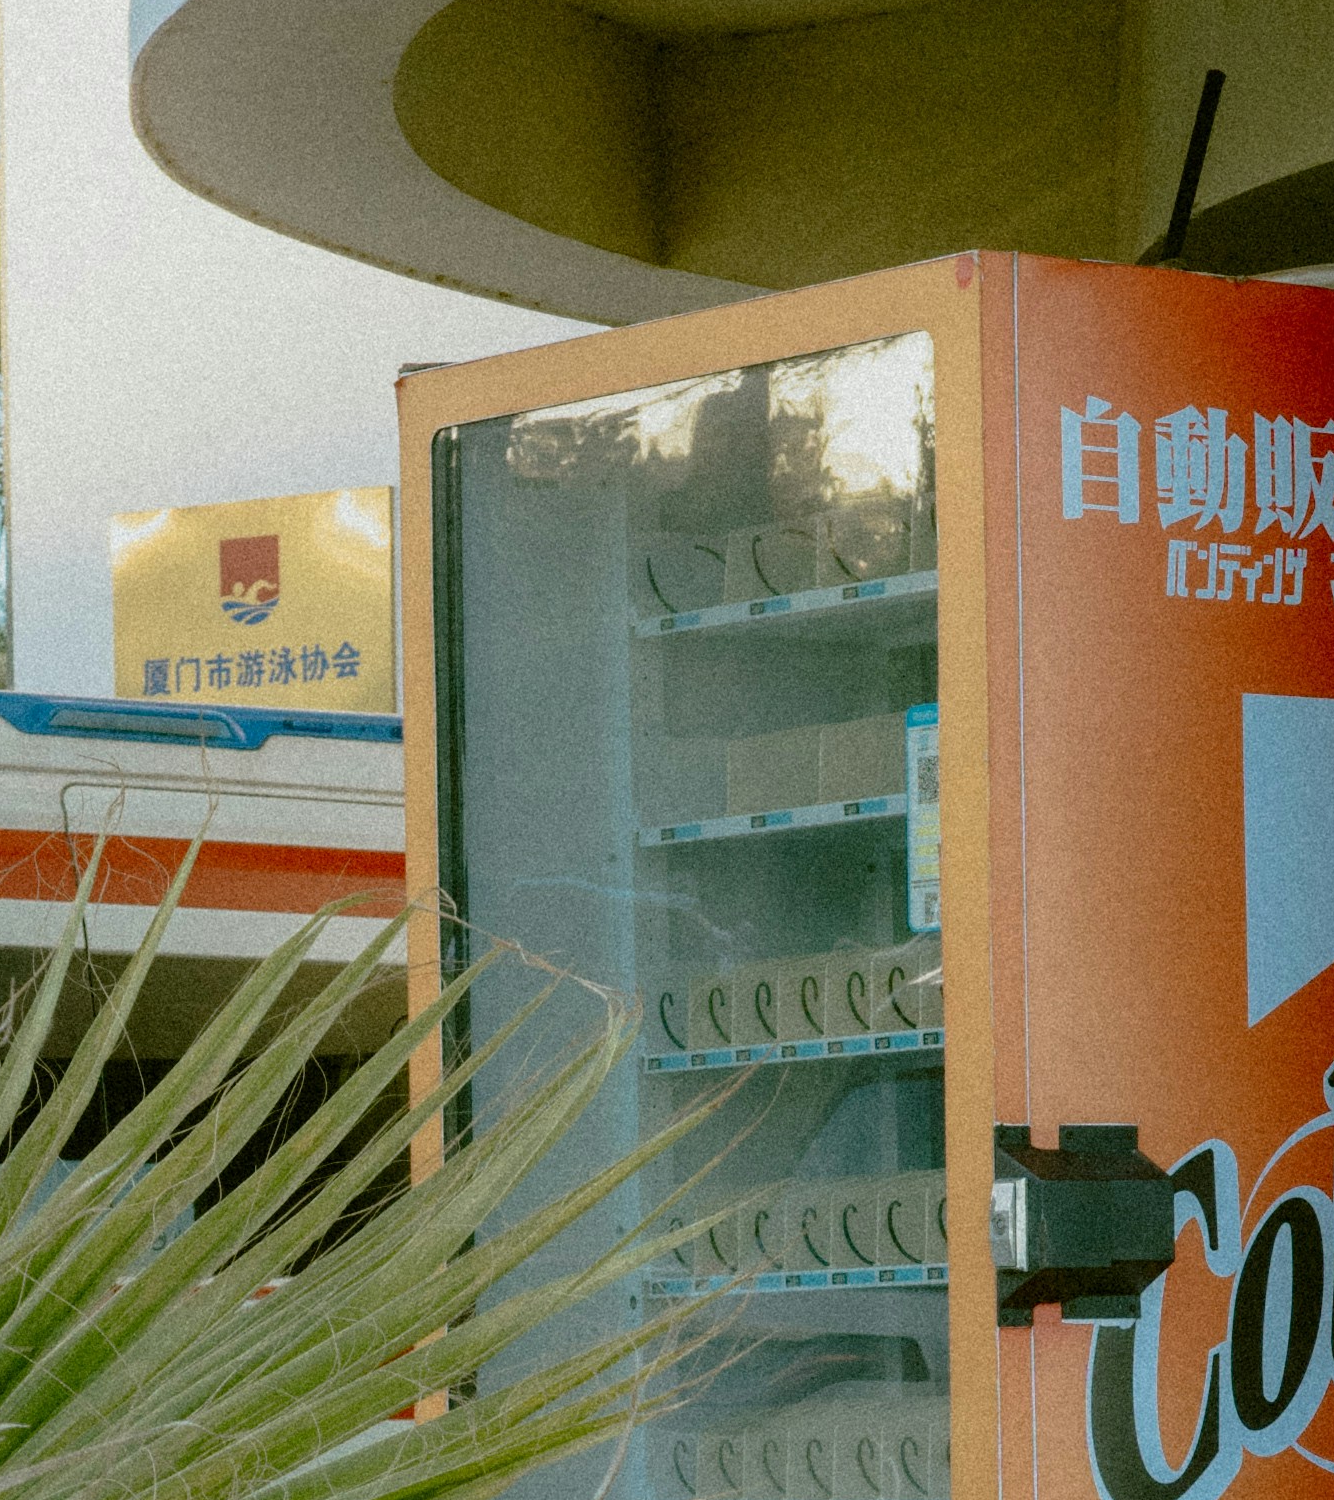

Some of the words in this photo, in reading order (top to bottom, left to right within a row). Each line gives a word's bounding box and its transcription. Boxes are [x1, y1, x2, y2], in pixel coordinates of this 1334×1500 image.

[142, 641, 362, 697] 厦门市游泳协会
